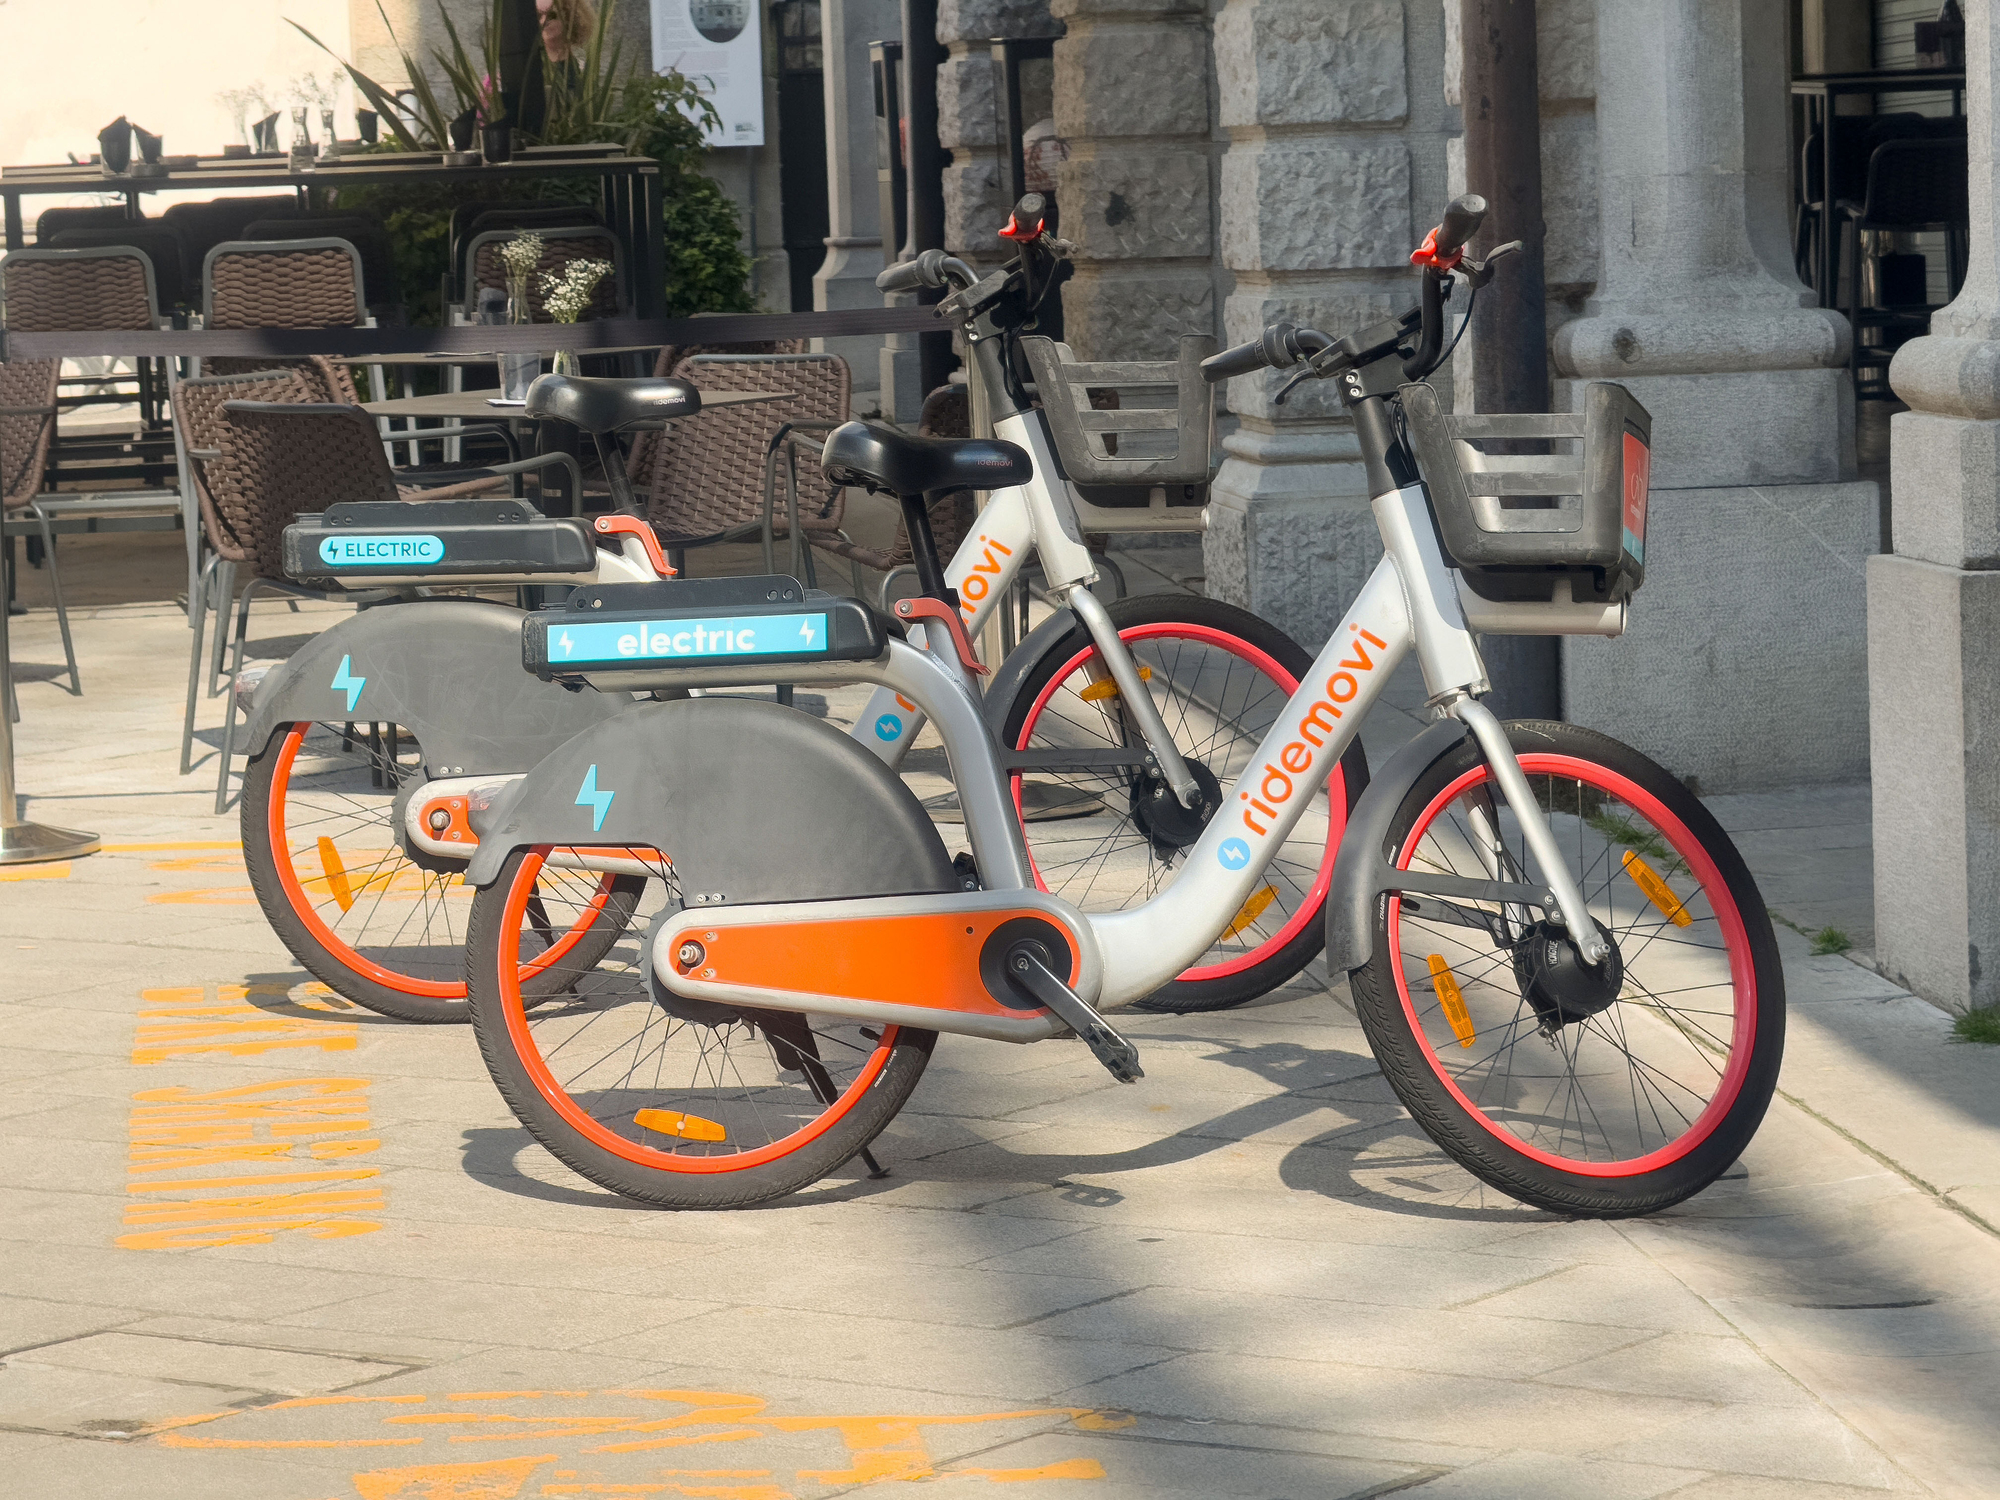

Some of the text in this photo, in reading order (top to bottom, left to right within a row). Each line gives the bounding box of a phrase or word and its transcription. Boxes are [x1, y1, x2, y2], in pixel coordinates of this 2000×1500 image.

[976, 459, 1013, 467] idemovi
[345, 541, 431, 557] ELECTRIC
[617, 623, 756, 656] electric
[1240, 622, 1388, 836] ridemovi
